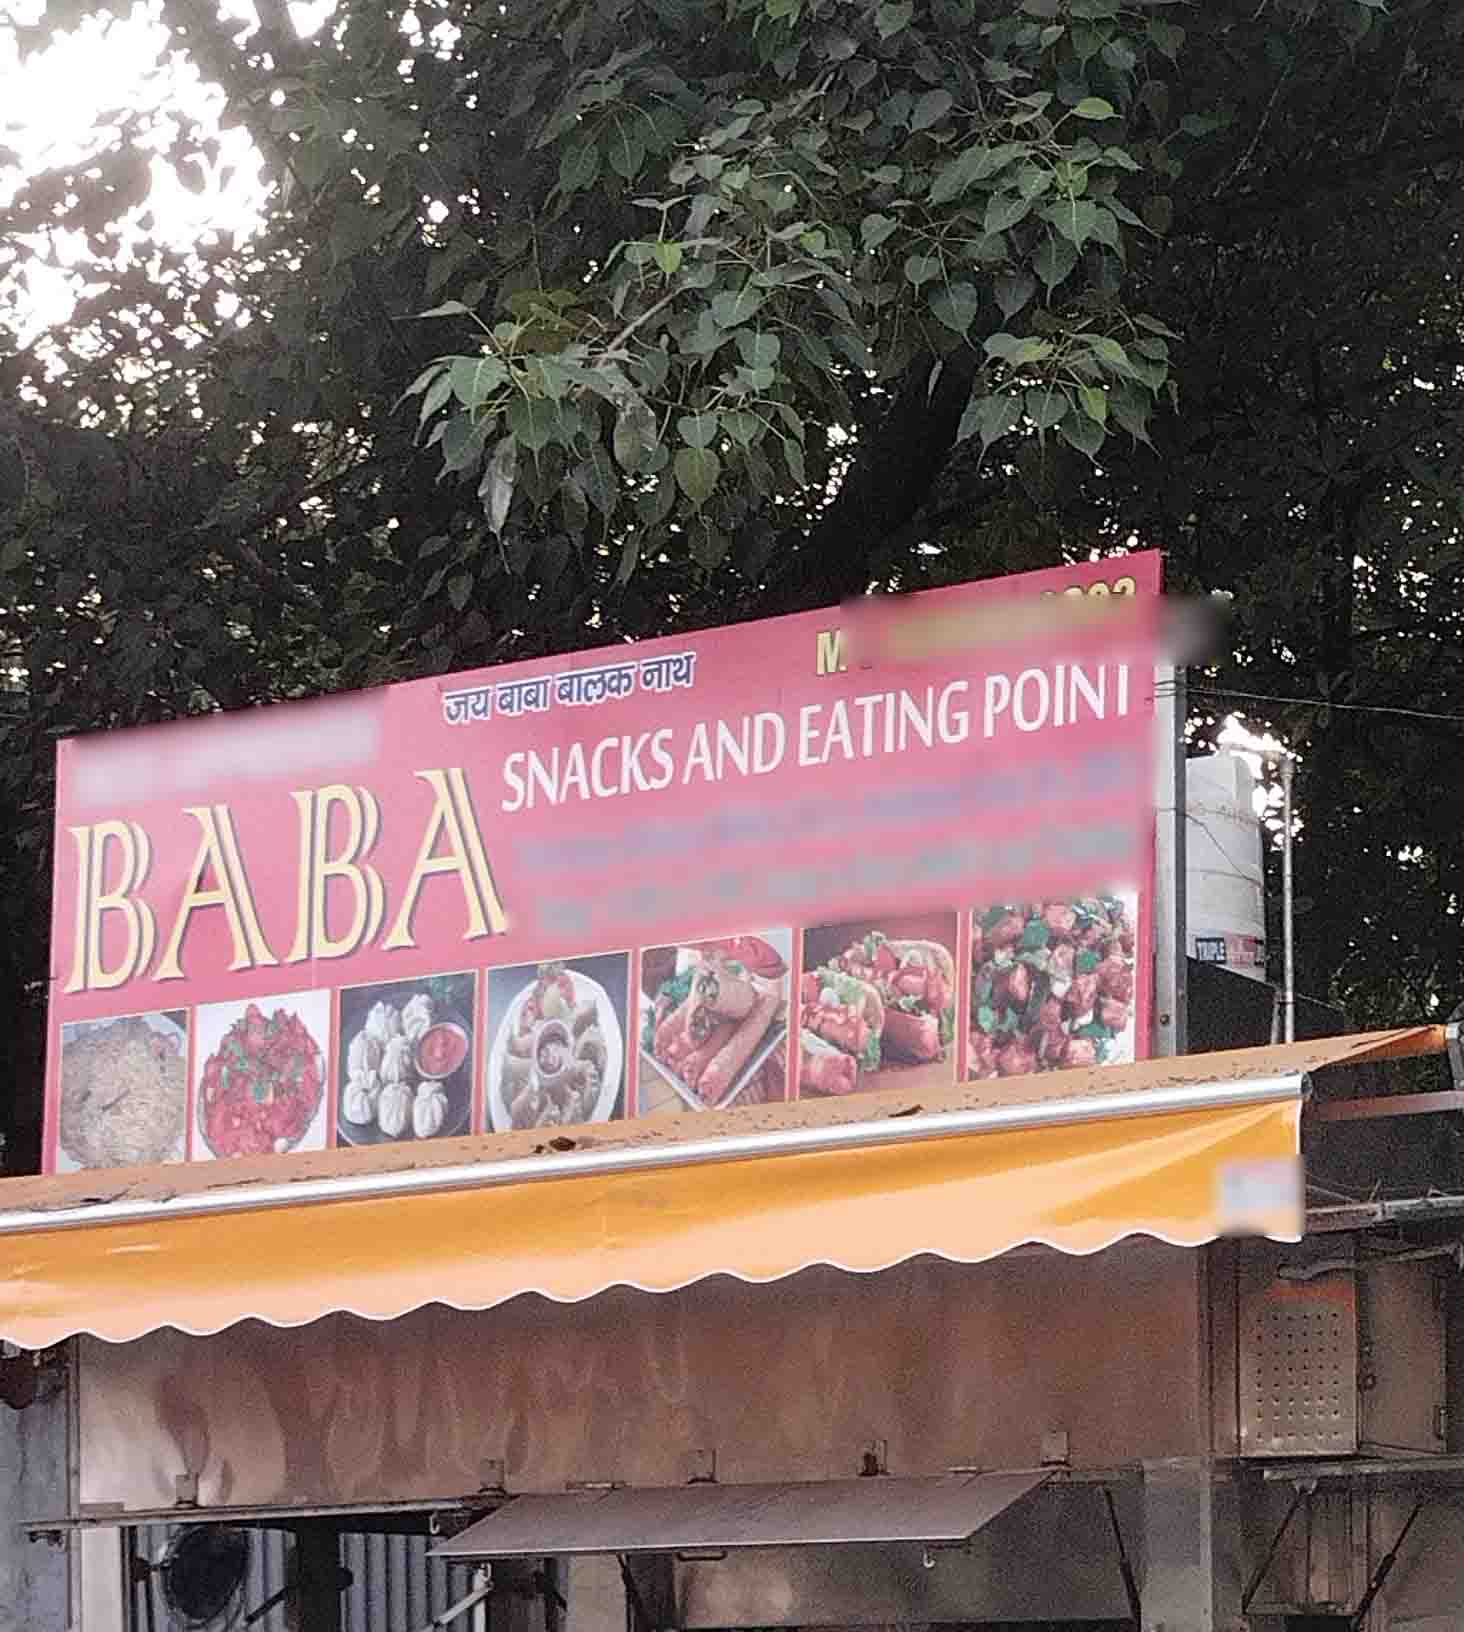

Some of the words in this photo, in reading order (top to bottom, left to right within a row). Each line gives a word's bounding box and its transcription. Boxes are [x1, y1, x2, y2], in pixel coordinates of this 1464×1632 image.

[445, 687, 491, 725] जय
[496, 675, 552, 716] बाबा
[551, 662, 637, 706] बालक
[640, 652, 696, 693] नाथ
[502, 729, 674, 811] SNACKS
[682, 712, 786, 785] AND
[799, 680, 969, 767] EATING
[64, 767, 508, 995] BABA
